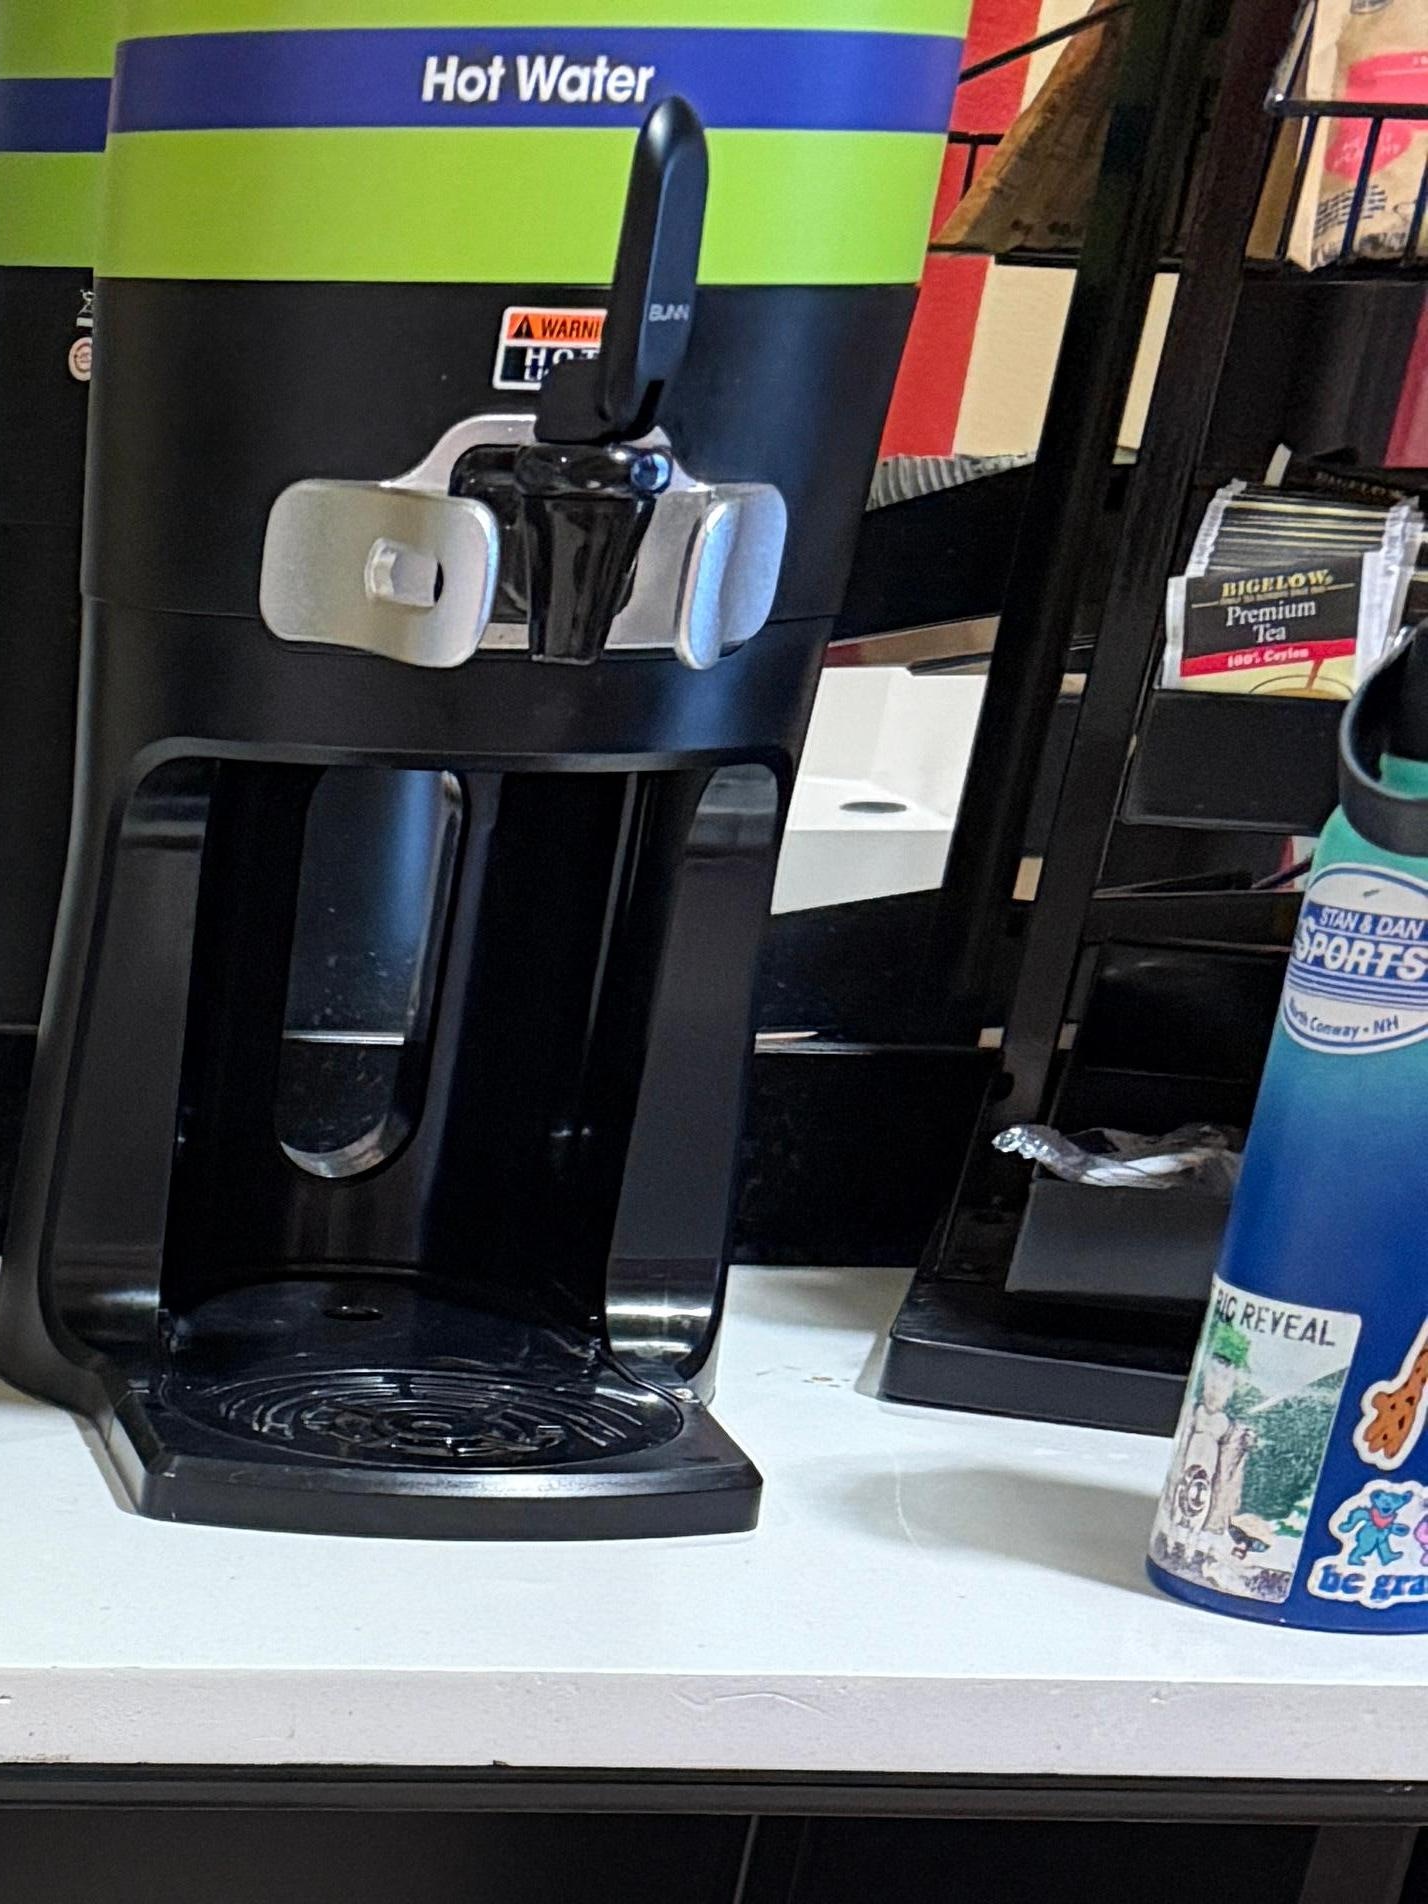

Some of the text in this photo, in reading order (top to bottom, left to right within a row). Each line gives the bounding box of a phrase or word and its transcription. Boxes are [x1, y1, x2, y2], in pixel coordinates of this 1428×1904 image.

[422, 55, 655, 103] Hot Water
[541, 318, 599, 339] WARNI
[1222, 569, 1332, 598] BIGELOW
[1226, 601, 1316, 627] Premium
[1253, 625, 1287, 644] Tea
[1320, 907, 1425, 939] STAN & DAN
[1296, 916, 1428, 981] SPORTS
[1309, 1016, 1361, 1039] Conway
[1374, 1015, 1399, 1034] NH
[1240, 1301, 1336, 1347] REVEAL
[1318, 1564, 1366, 1594] be
